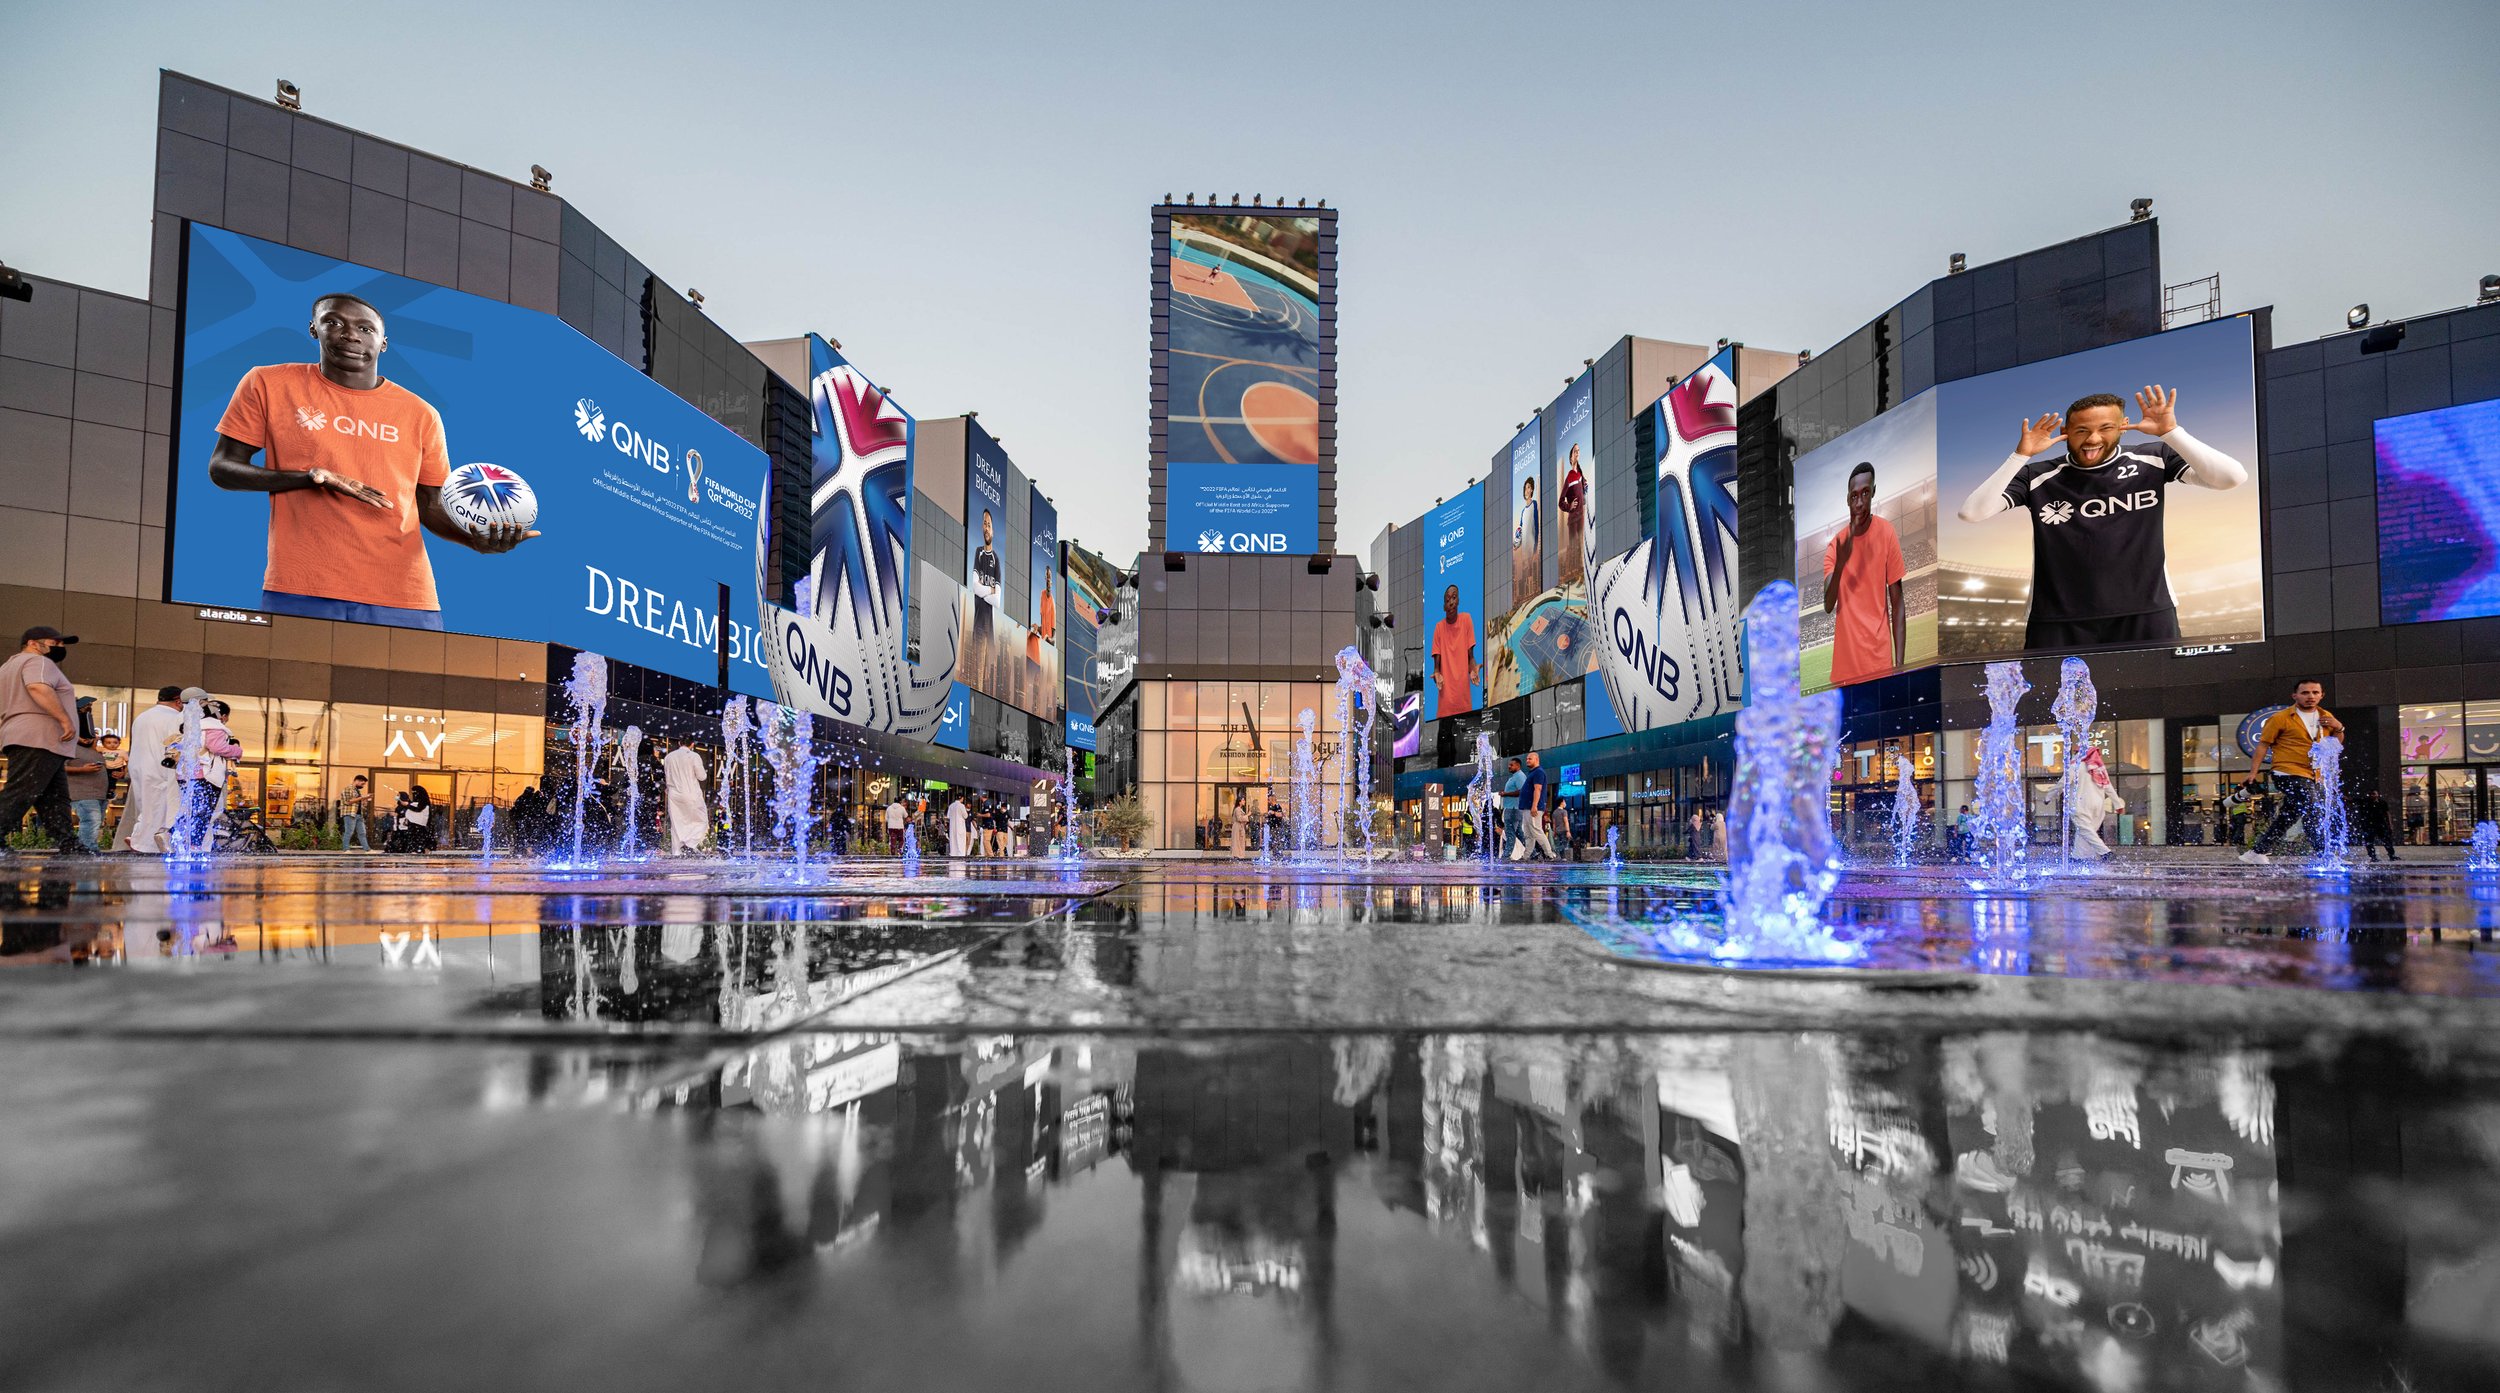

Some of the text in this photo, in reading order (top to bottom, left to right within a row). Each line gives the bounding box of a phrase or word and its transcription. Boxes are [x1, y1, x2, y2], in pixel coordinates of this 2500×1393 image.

[333, 415, 400, 443] QNB
[611, 421, 670, 474] QNB
[1514, 435, 1536, 460] DREAM
[975, 453, 1001, 488] DREAM
[1514, 450, 1536, 474] BIGGER
[2117, 464, 2139, 479] 22
[704, 476, 757, 512] FIFA WORLD CUP
[975, 474, 1001, 507] BIGGER
[455, 505, 488, 526] QNB
[2080, 489, 2159, 518] QNB
[1229, 532, 1288, 553] QNB
[1448, 526, 1465, 542] QNB
[199, 608, 247, 622] alarabia
[585, 564, 719, 655] DREAM
[1613, 607, 1680, 702] QNB
[786, 621, 853, 717] QNB
[382, 714, 397, 722] LE
[1078, 722, 1095, 733] QNB
[1220, 723, 1249, 732] THE
[1649, 788, 1671, 797] ANGELES
